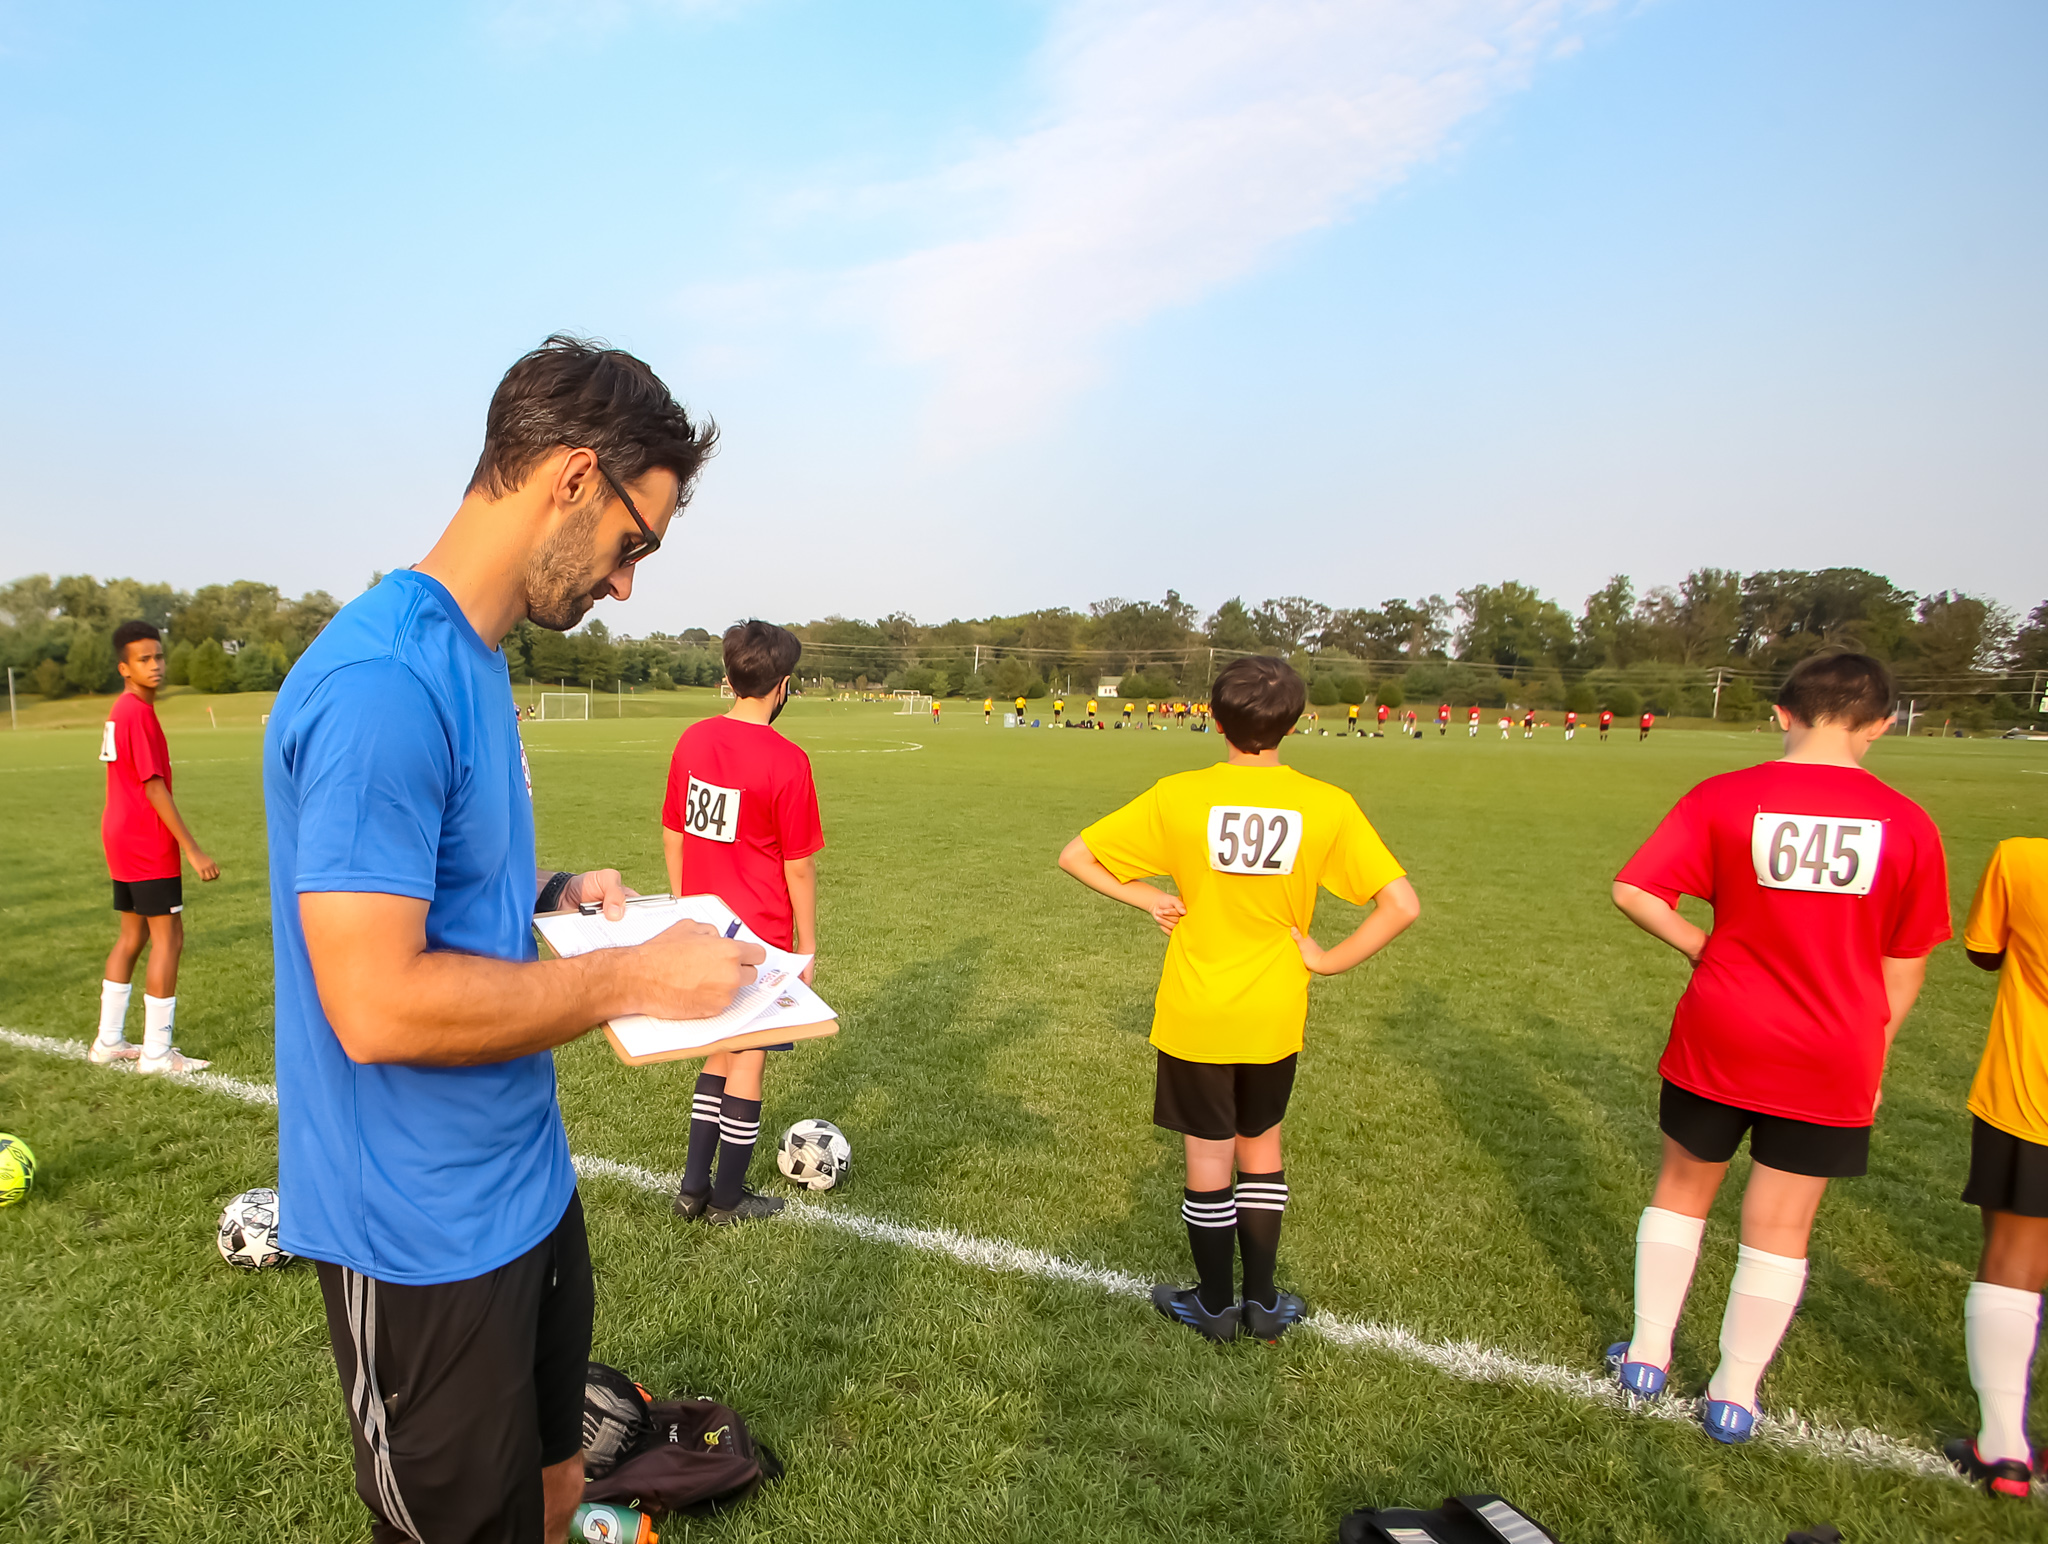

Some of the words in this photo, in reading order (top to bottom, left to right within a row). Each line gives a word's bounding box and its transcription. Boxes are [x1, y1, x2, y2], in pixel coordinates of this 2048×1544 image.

[685, 783, 727, 836] 584
[1218, 812, 1288, 869] 592
[1769, 821, 1862, 887] 645
